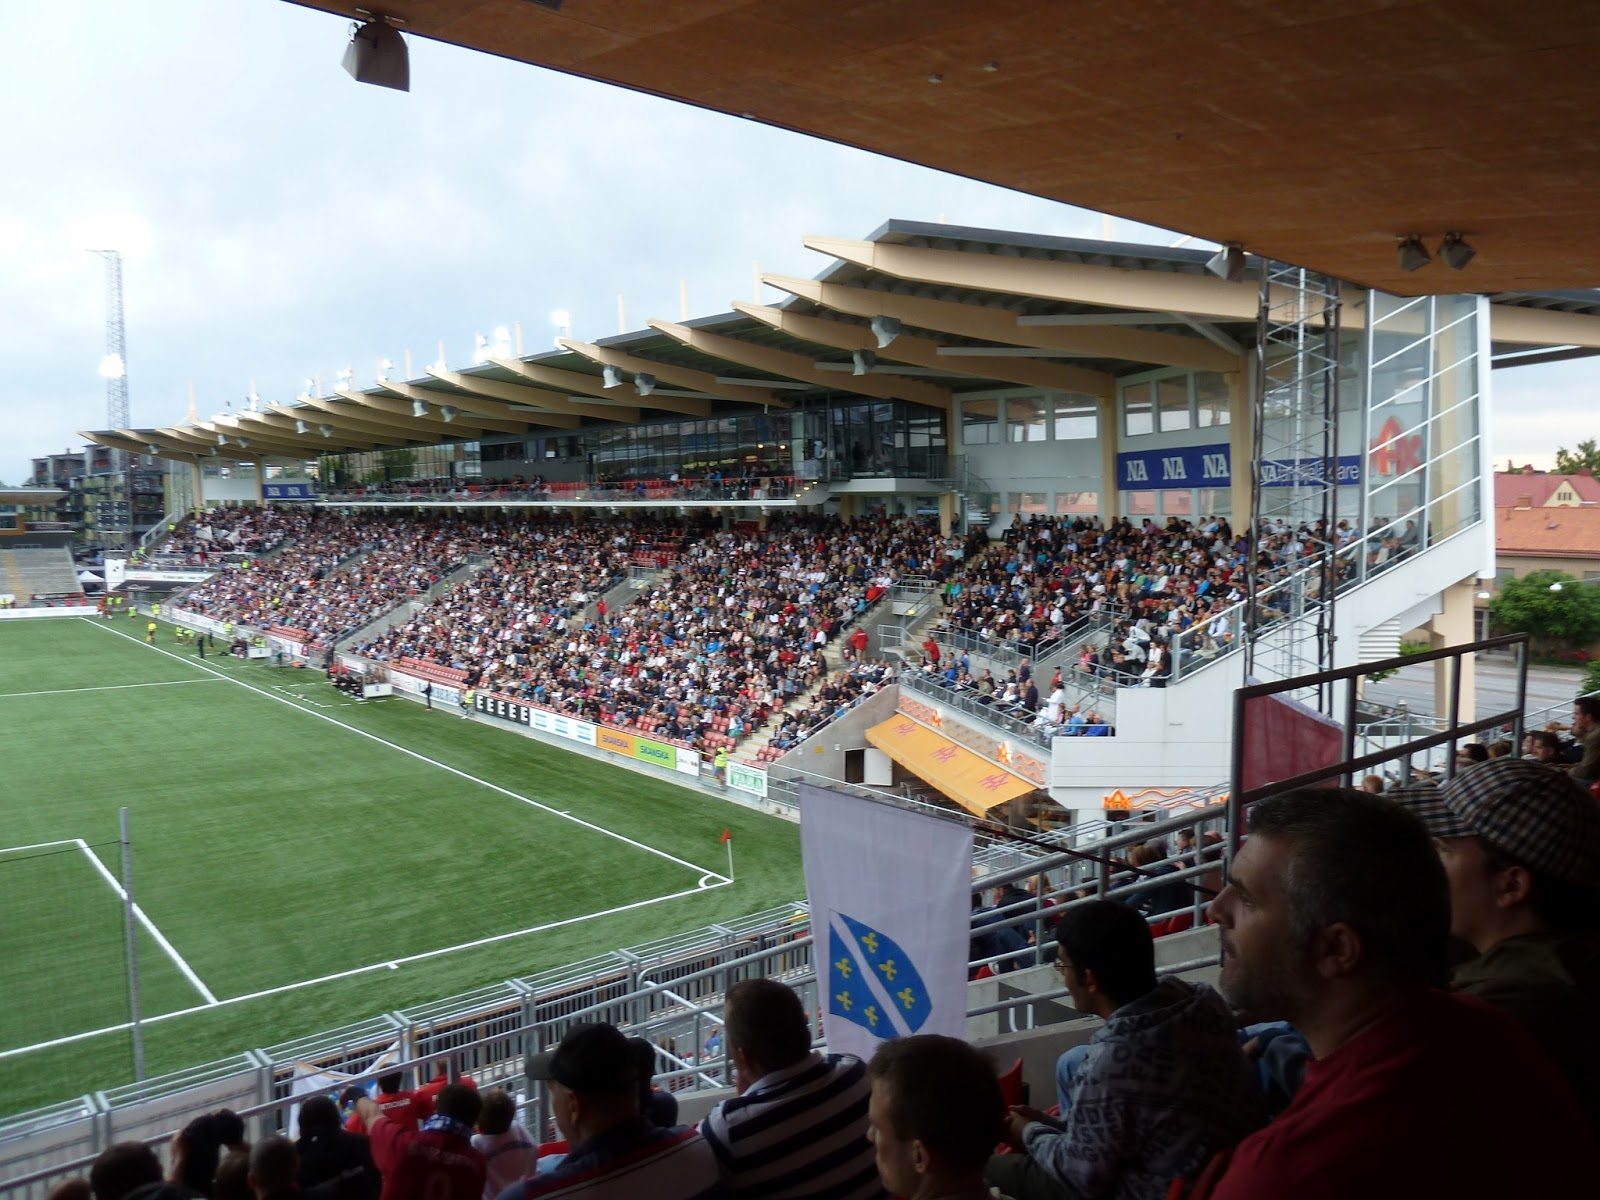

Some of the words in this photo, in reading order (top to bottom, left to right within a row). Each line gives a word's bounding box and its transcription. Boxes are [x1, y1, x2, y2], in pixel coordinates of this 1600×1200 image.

[1126, 459, 1149, 481] NA
[1162, 456, 1187, 480] NA
[1202, 453, 1230, 478] NA
[640, 745, 667, 760] SKANSKA
